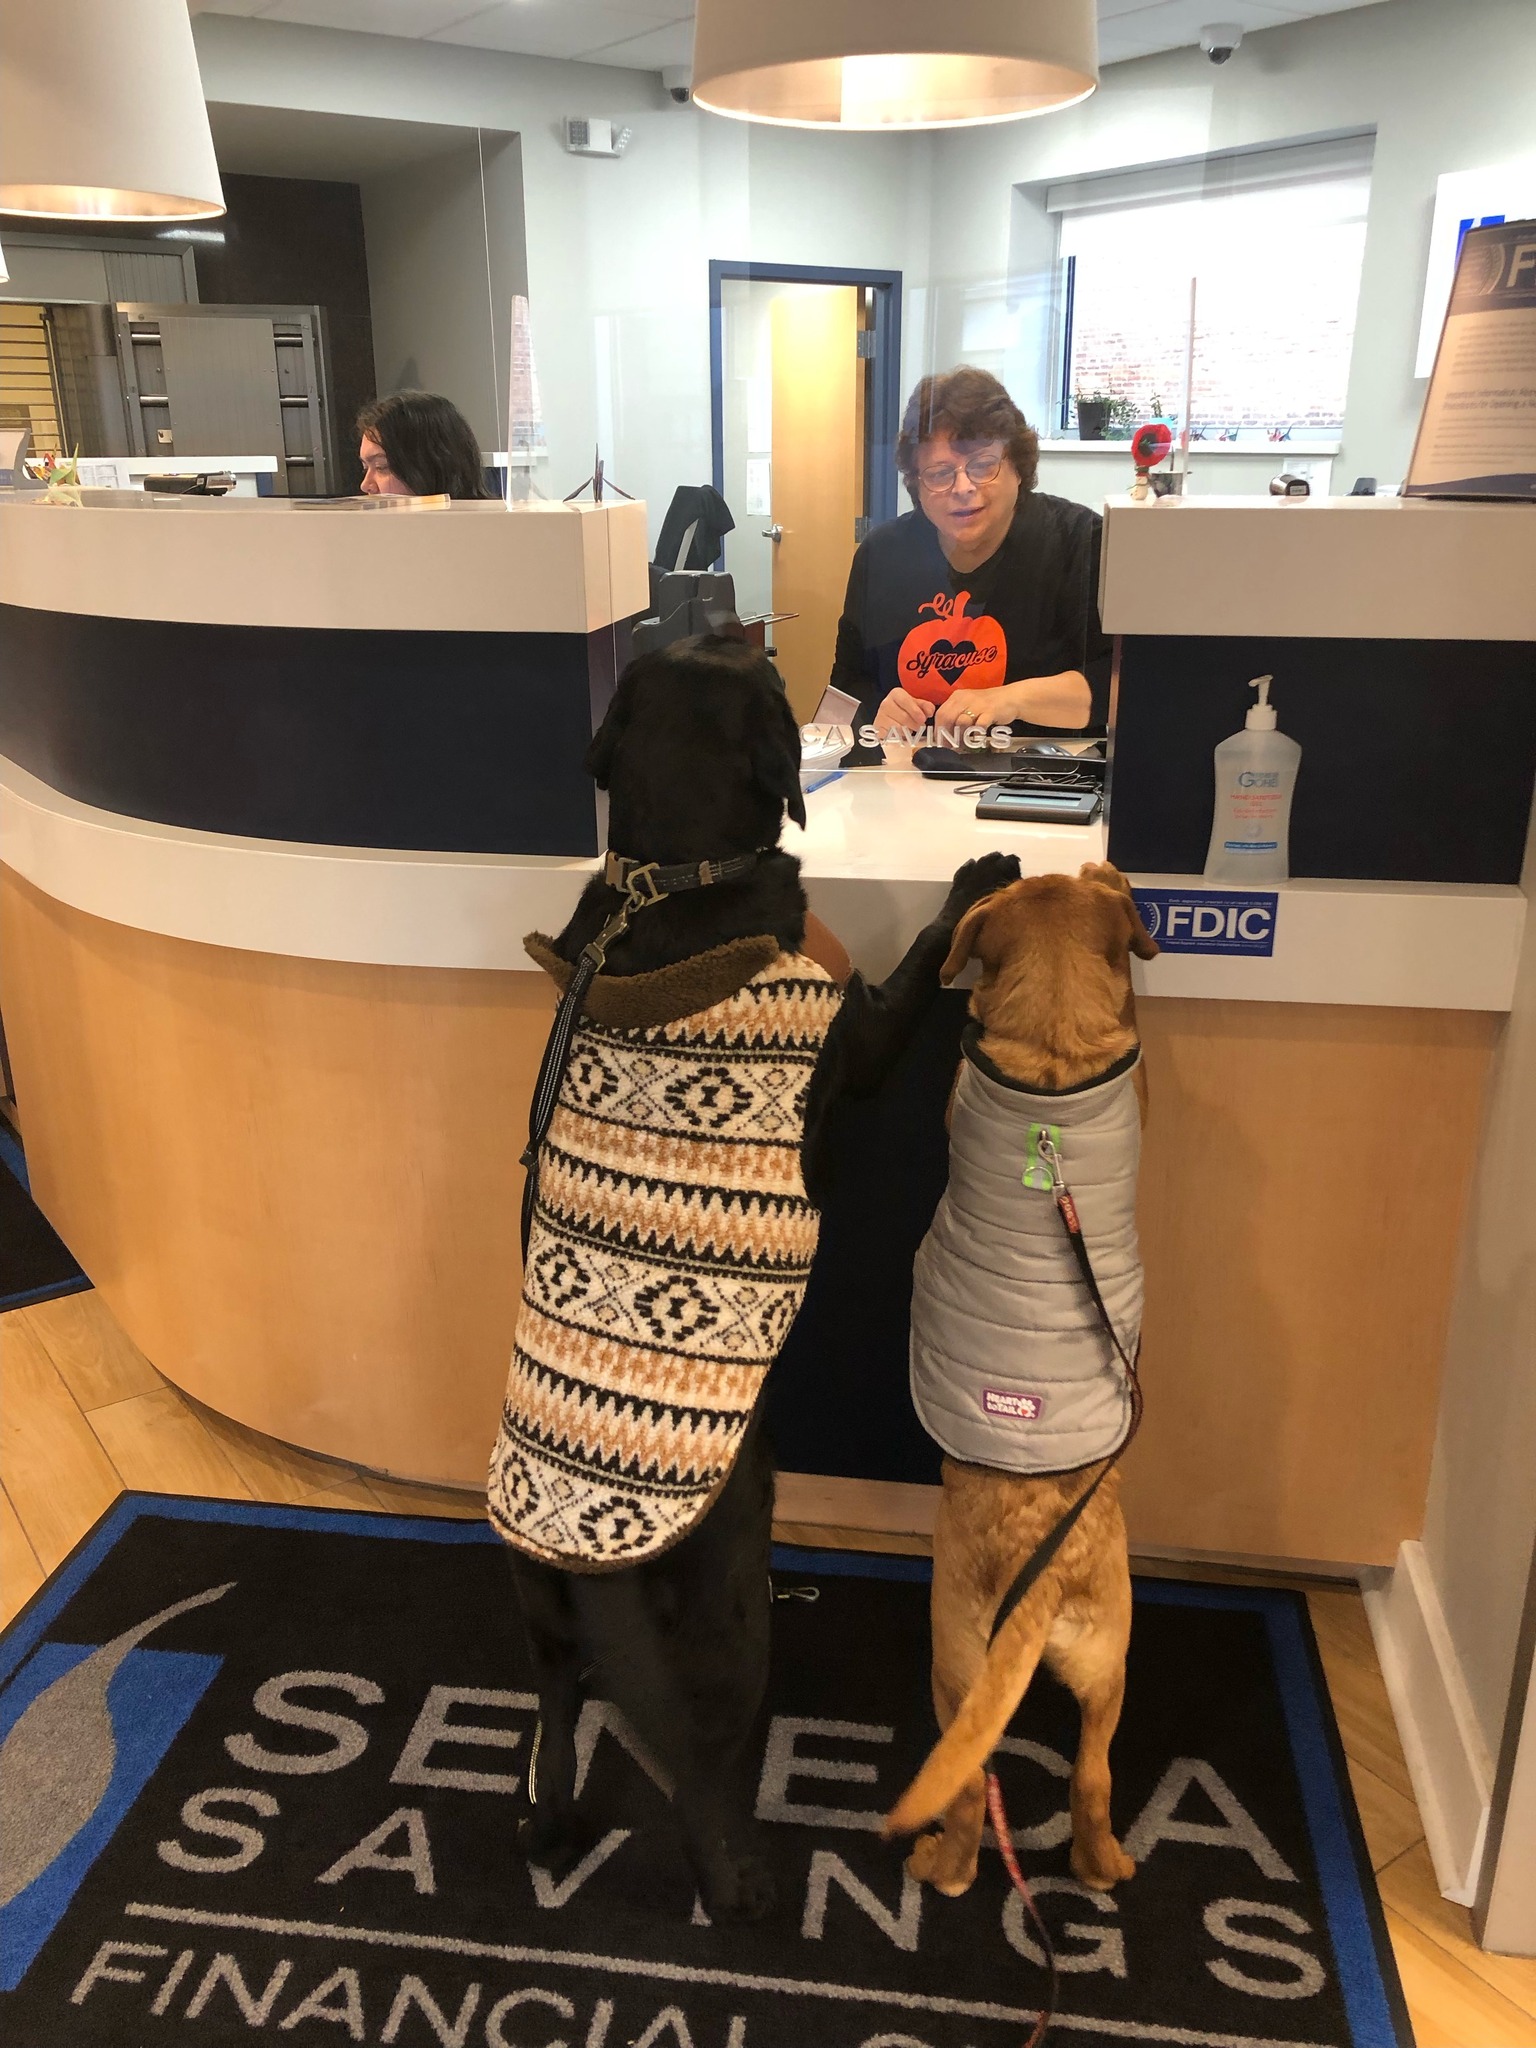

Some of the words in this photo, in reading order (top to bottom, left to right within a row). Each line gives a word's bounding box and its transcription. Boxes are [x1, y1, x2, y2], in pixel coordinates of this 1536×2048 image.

[906, 646, 998, 679] Syracuse
[858, 724, 1013, 748] SAVINGS
[1166, 905, 1272, 941] FDIC
[156, 1786, 1327, 2000] SAVNGS
